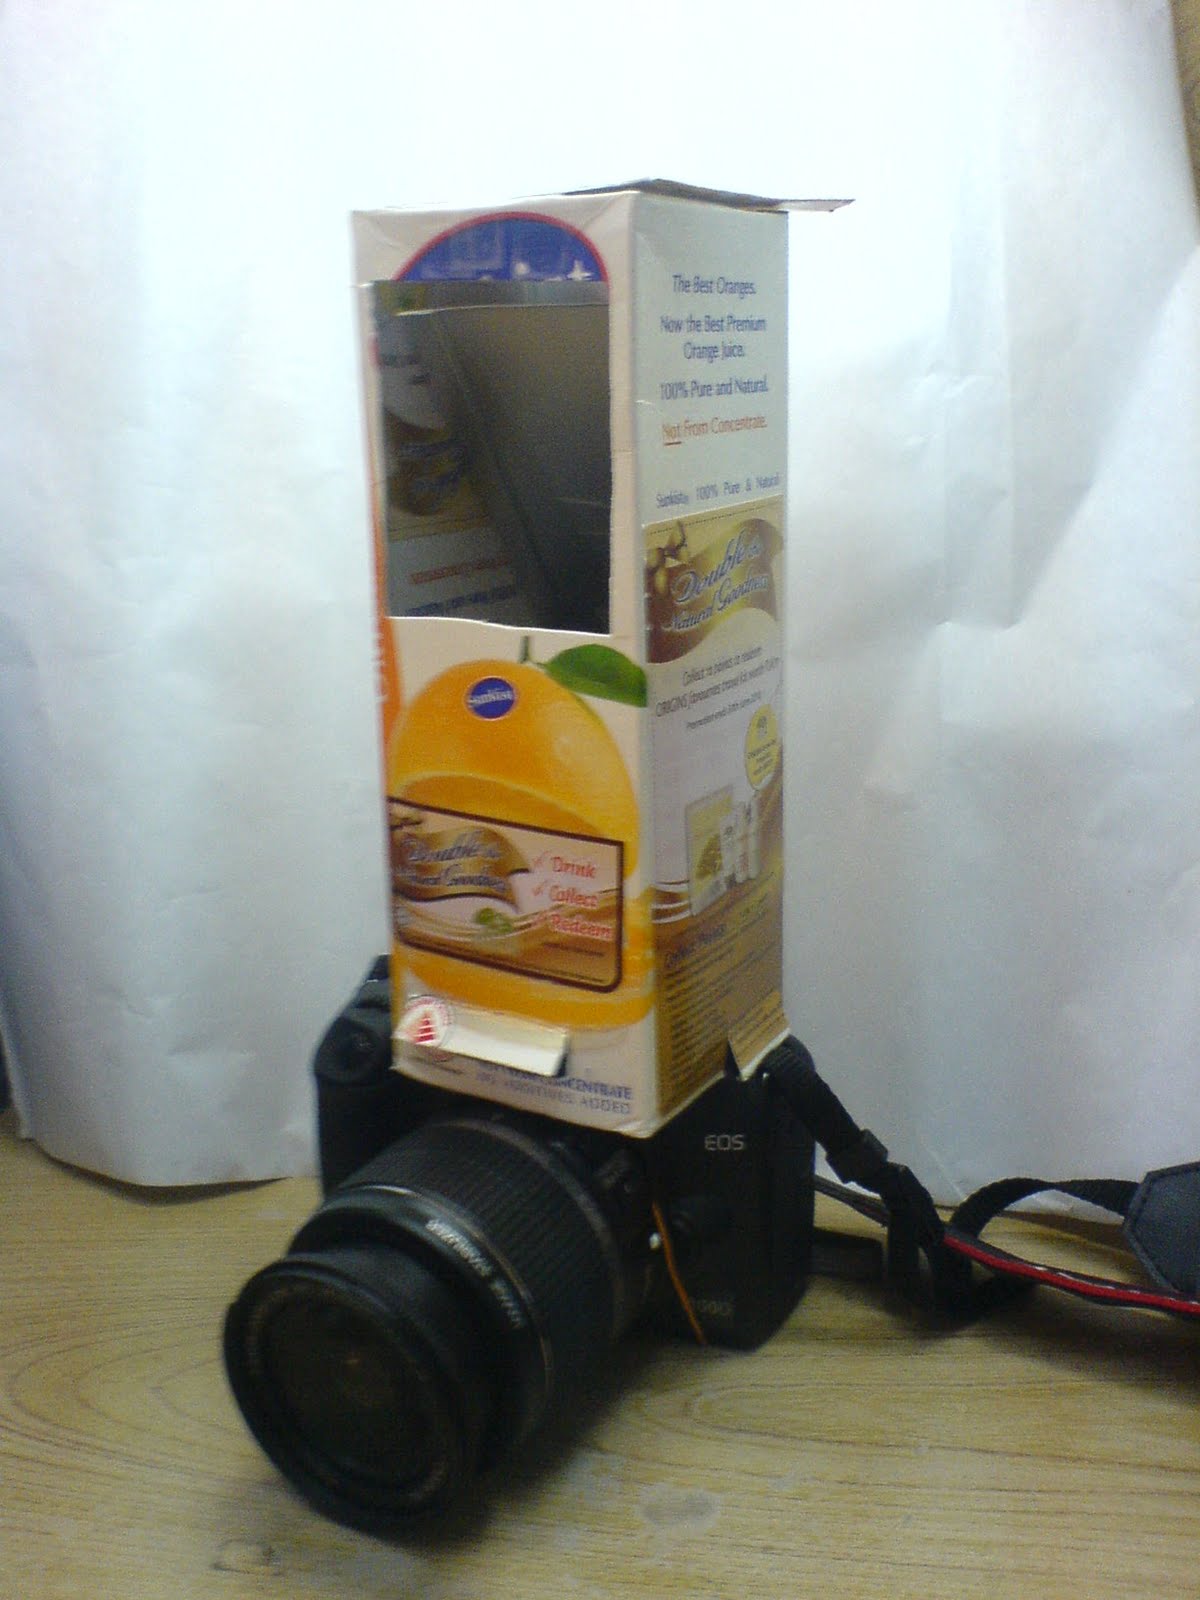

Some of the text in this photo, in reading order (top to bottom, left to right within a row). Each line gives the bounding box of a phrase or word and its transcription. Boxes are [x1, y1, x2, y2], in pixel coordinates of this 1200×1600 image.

[673, 275, 757, 299] The Best Oranges.
[660, 315, 766, 333] Now the Best Premium
[684, 342, 719, 363] Orange
[661, 382, 688, 400] 100%
[691, 380, 713, 397] Pure
[716, 378, 732, 395] and
[662, 424, 681, 440] Not
[684, 418, 708, 437] From
[672, 529, 749, 602] Double
[664, 568, 770, 631] Natural Goodness
[551, 855, 596, 879] Drink
[550, 913, 614, 939] Redeem
[704, 1134, 744, 1151] EOS
